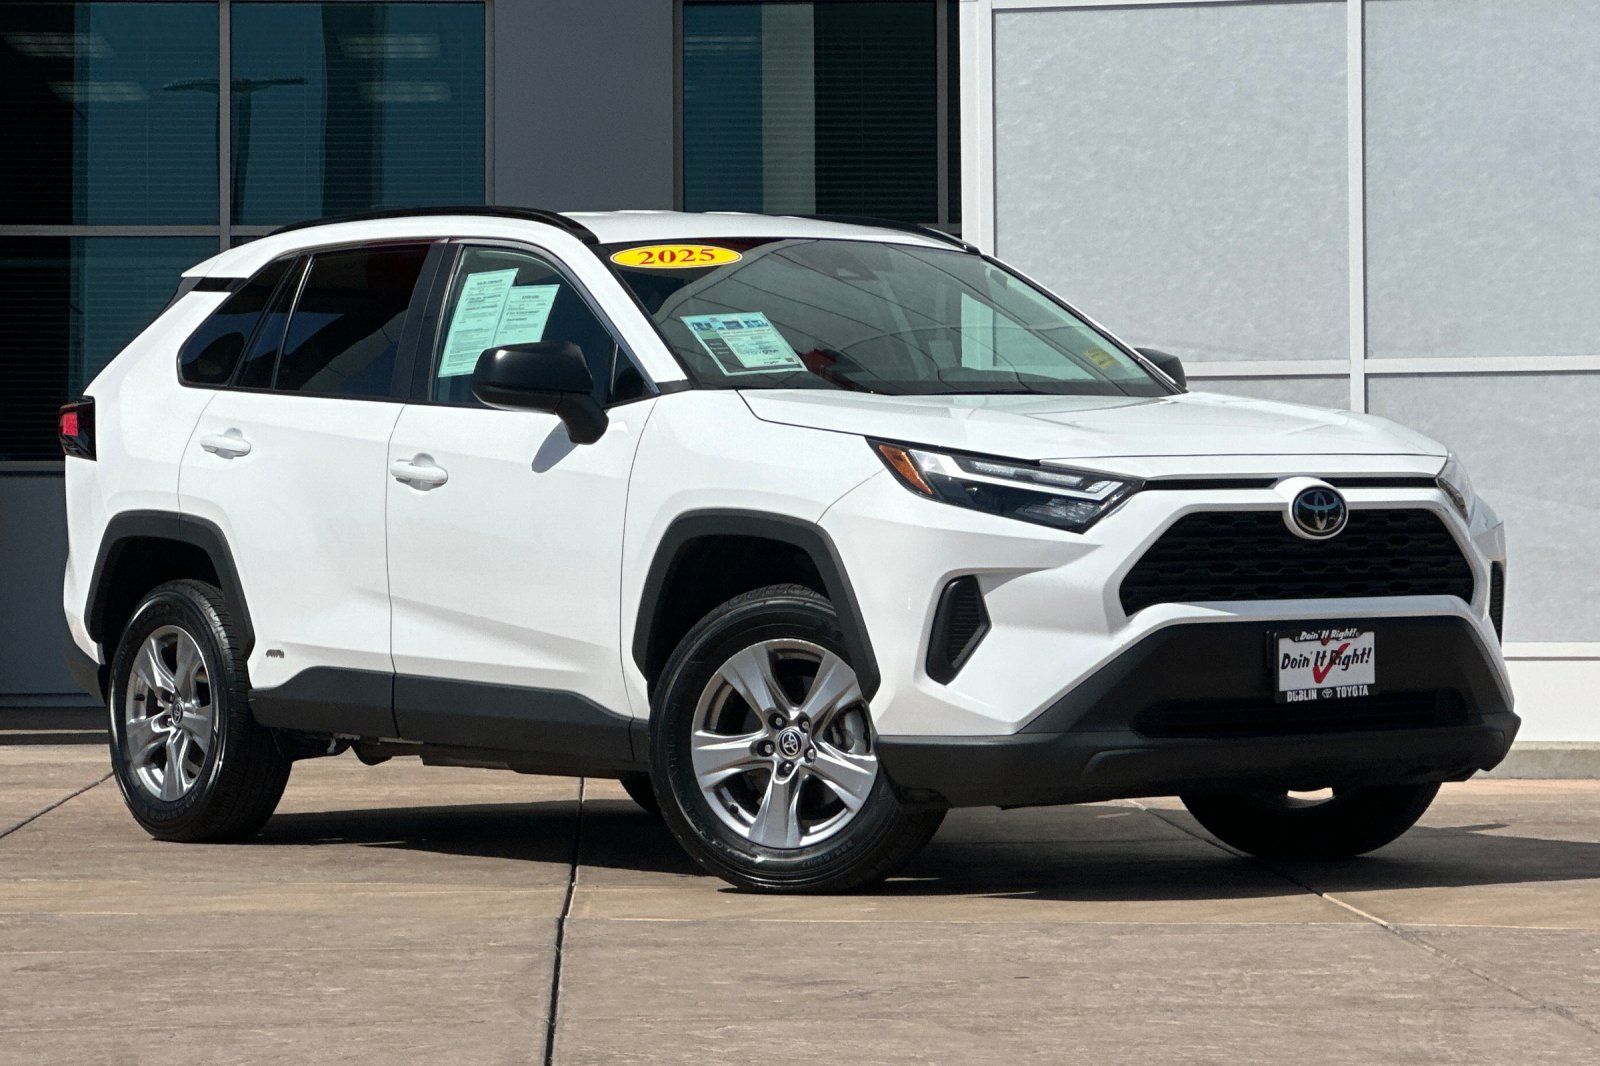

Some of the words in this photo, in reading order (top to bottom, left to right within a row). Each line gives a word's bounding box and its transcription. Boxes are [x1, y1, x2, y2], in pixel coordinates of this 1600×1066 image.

[637, 248, 716, 265] 2025
[1321, 630, 1330, 639] It
[1330, 628, 1357, 639] Right!
[1281, 651, 1313, 670] Doin'
[1314, 650, 1328, 667] It
[1329, 647, 1373, 671] Right!
[1286, 689, 1317, 702] DUBLIN
[1336, 685, 1369, 698] TOYOTA
